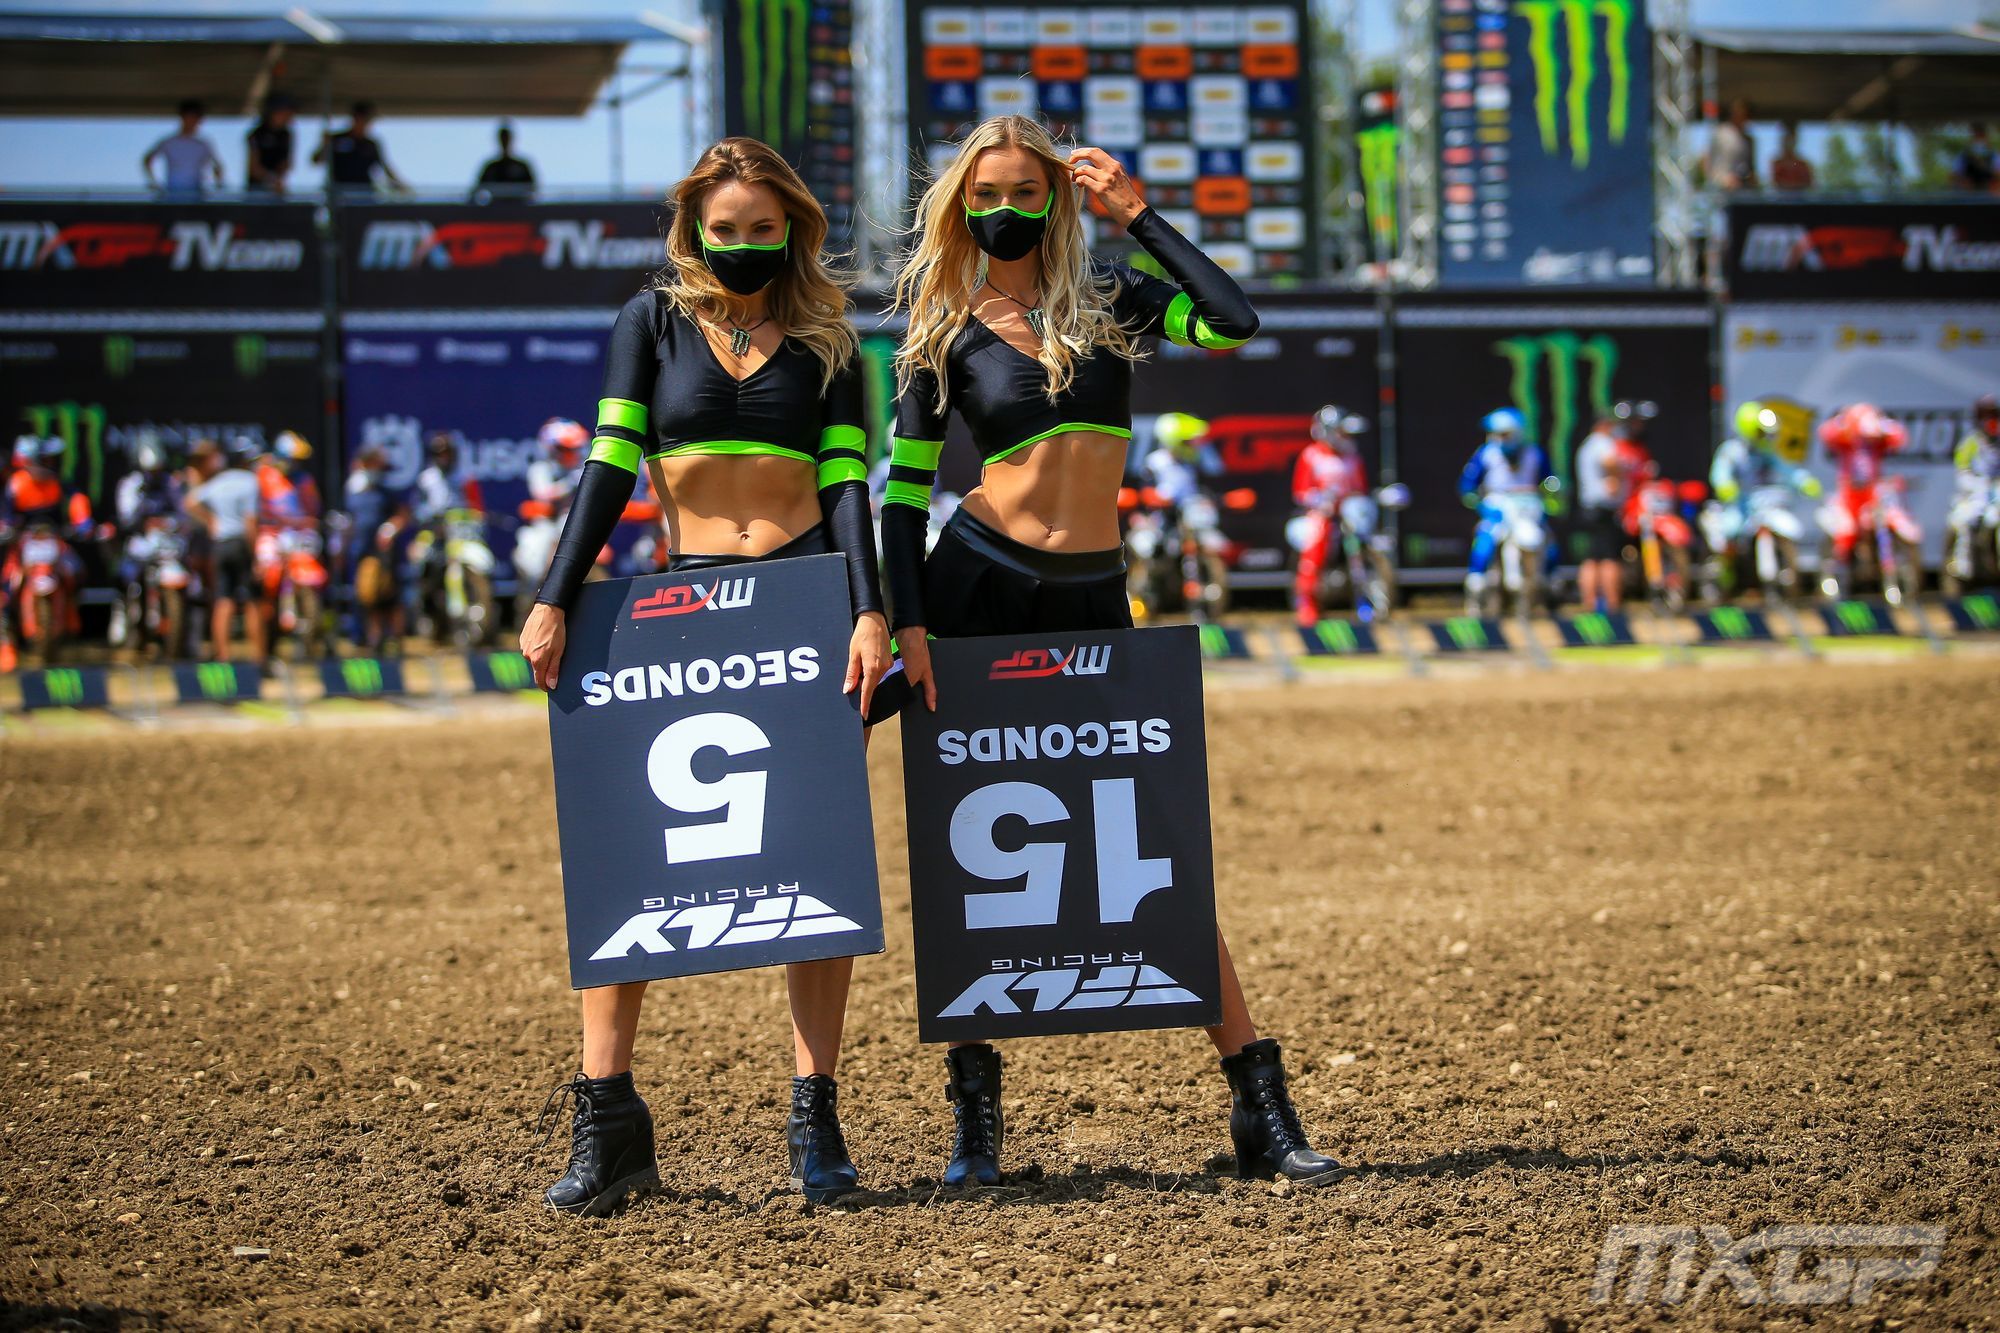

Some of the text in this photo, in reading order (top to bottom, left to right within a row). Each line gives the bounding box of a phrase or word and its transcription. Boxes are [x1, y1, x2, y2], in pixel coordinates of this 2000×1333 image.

[631, 577, 756, 620] MXGP
[581, 646, 820, 707] SECONDS
[988, 643, 1112, 680] MXGP
[937, 718, 1171, 765] SECONDS
[646, 711, 772, 865] 5
[949, 777, 1173, 930] 15
[642, 881, 799, 911] RACING
[588, 895, 863, 961] FLY
[991, 951, 1143, 970] RACING
[936, 965, 1203, 1018] FLY
